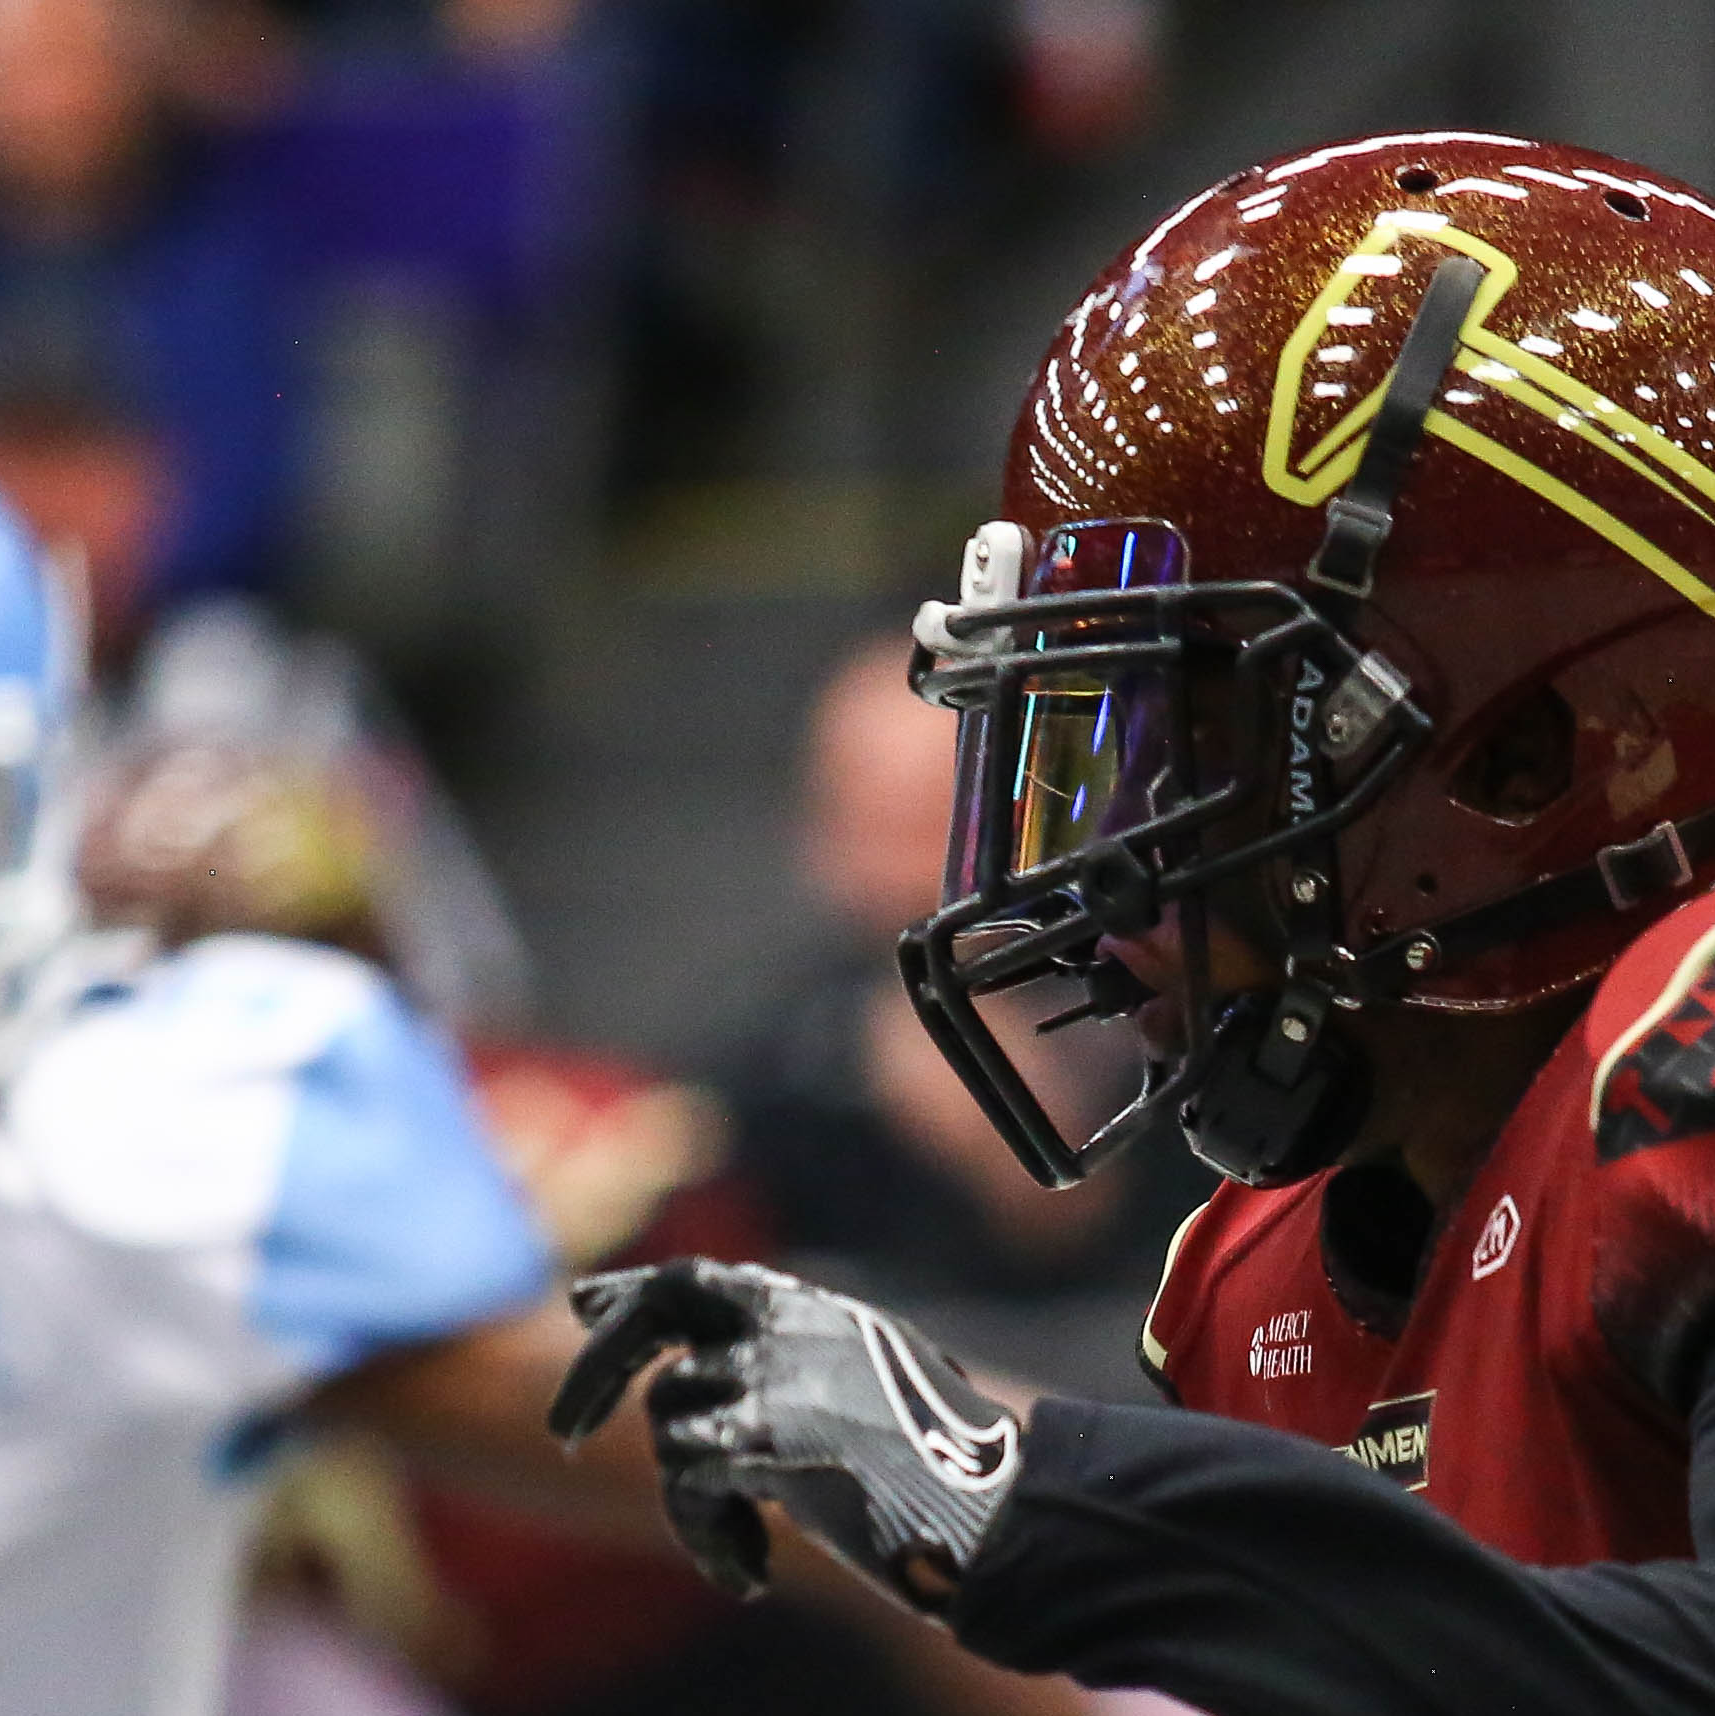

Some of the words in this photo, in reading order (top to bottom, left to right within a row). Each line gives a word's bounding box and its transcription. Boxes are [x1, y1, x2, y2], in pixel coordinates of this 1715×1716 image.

[1289, 658, 1325, 825] ADAM
[1264, 1308, 1313, 1345] MERCY
[1262, 1344, 1313, 1381] HEALTH
